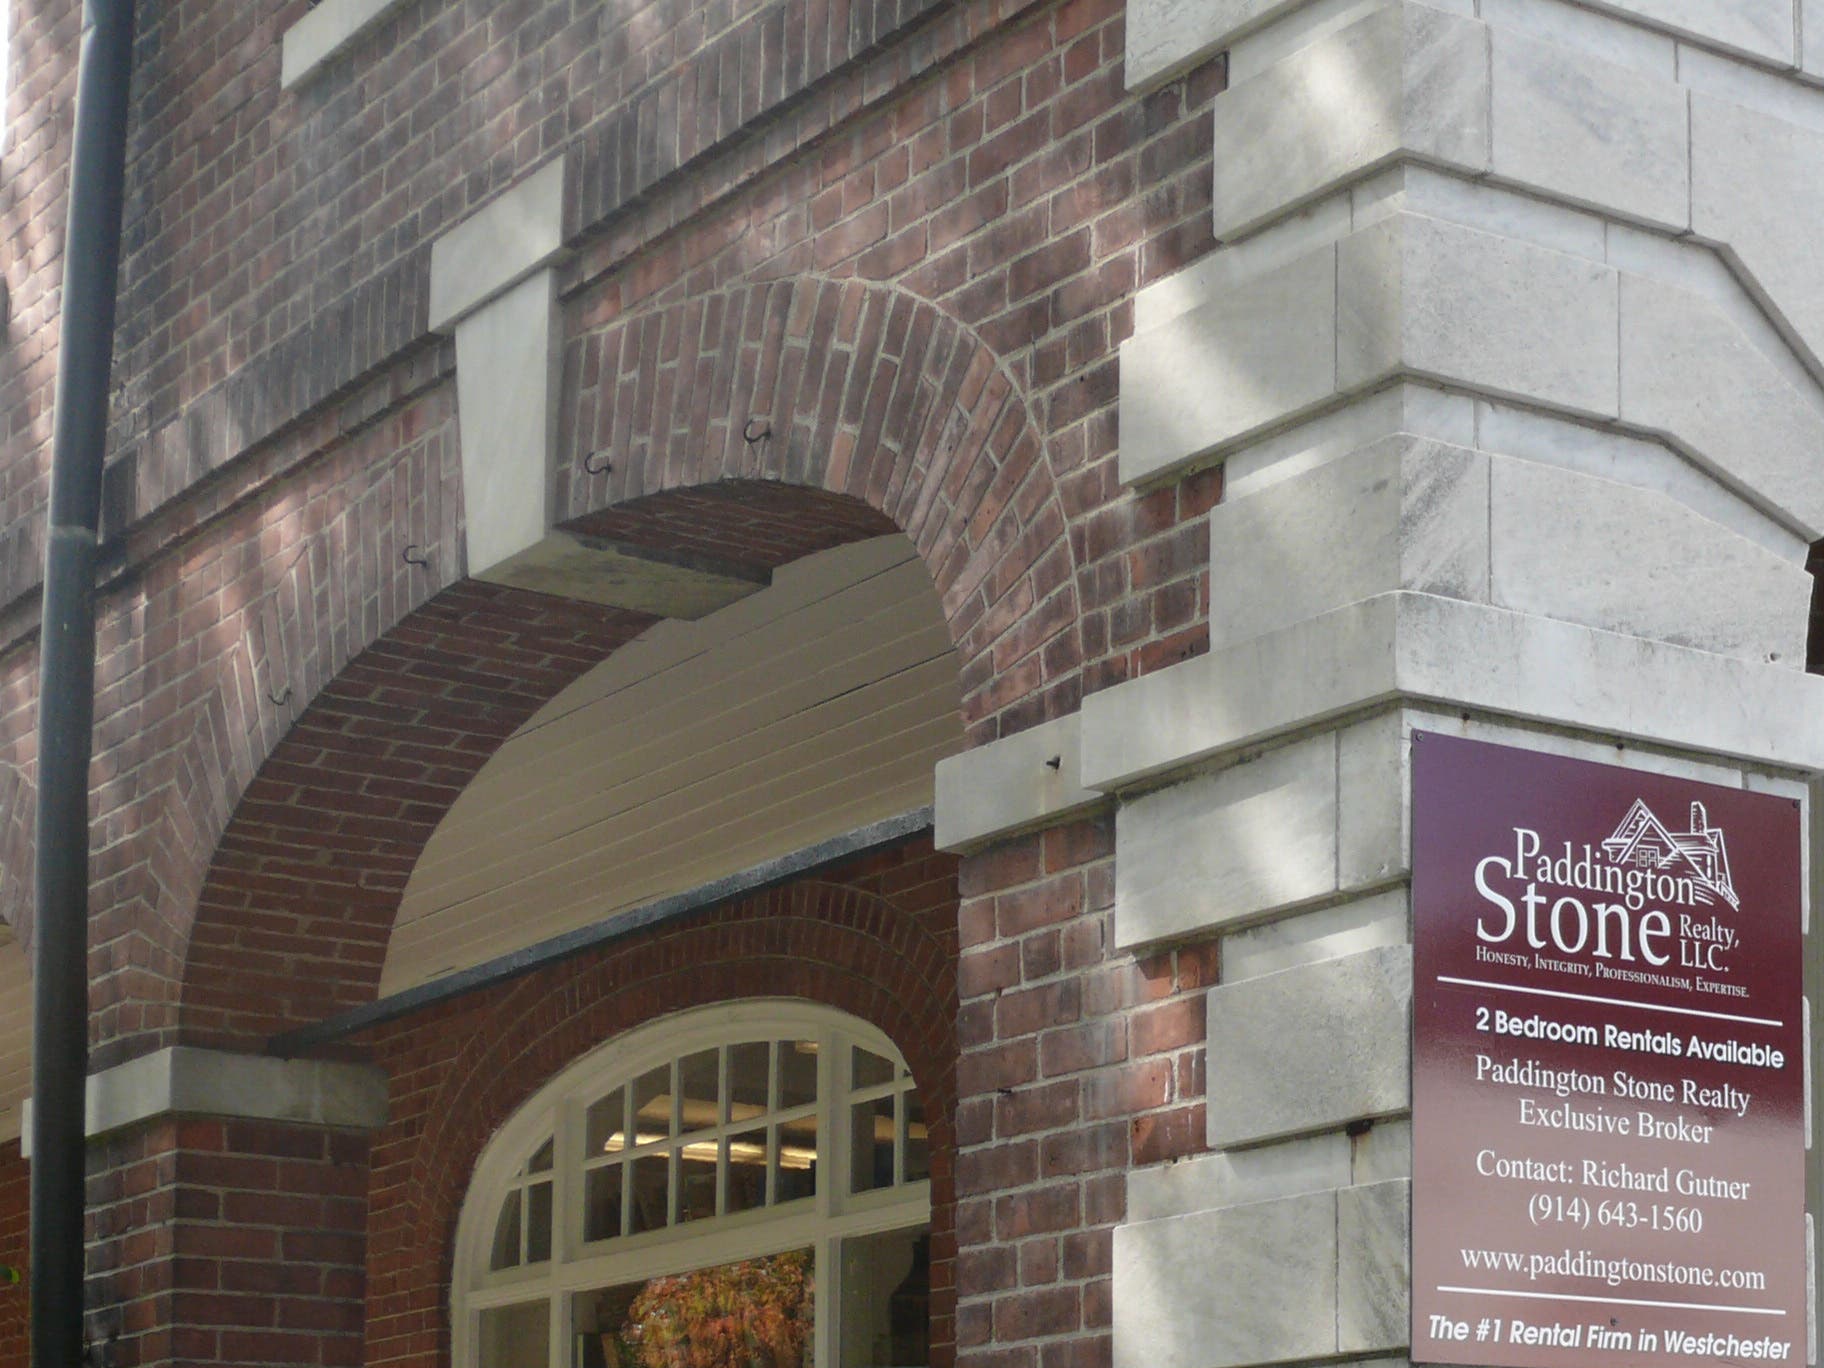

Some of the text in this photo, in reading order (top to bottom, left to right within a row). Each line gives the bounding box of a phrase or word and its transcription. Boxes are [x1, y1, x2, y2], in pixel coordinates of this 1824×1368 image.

[1513, 826, 1697, 911] Paddington
[1474, 855, 1671, 967] Stone
[1679, 914, 1740, 950] Realty,
[1679, 938, 1730, 973] LLC.
[1475, 1007, 1785, 1068] 2 Bedroom Rentals Available
[1475, 1055, 1751, 1117] Paddington Stone Realty
[1519, 1098, 1713, 1144] Exclusive Broker
[1476, 1149, 1750, 1200] Contact: Richard Gutner
[1529, 1193, 1703, 1234] (914) 643-1560
[1460, 1247, 1765, 1290] www.paddingtonstone.com
[1429, 1314, 1790, 1360] The #1 Rental Firm in Westchester
